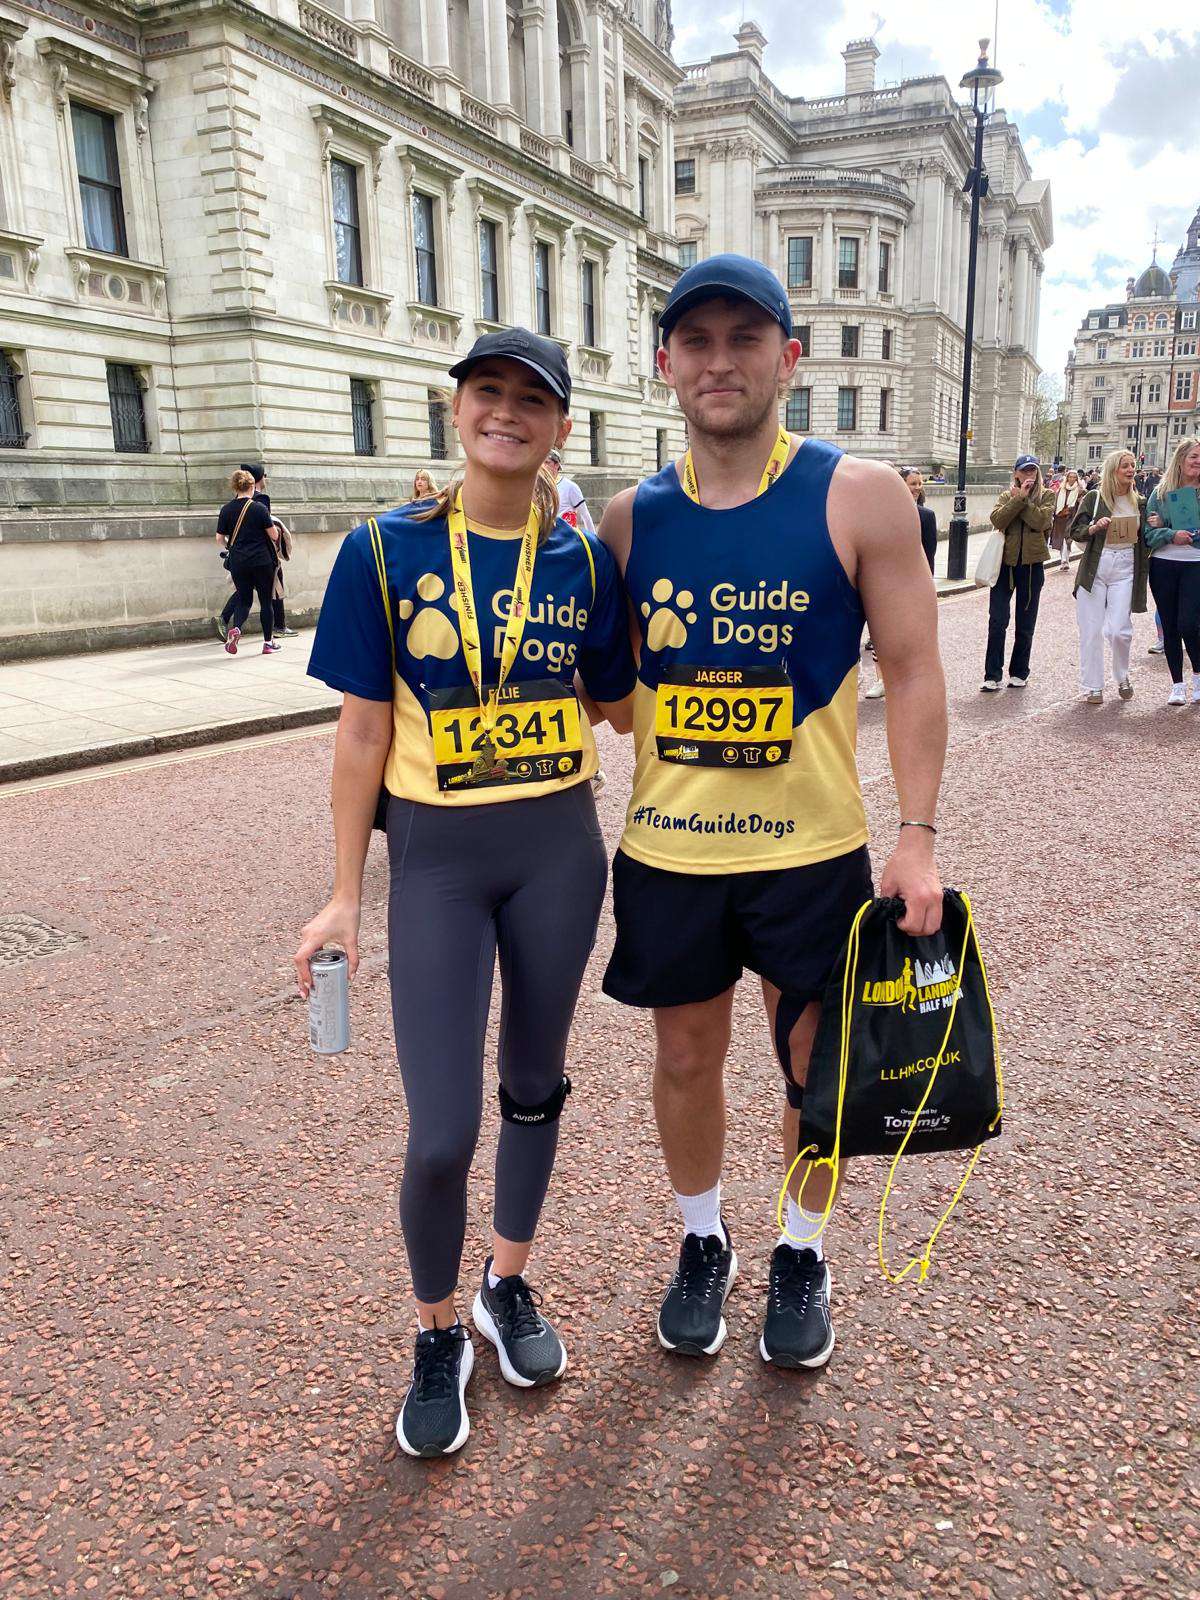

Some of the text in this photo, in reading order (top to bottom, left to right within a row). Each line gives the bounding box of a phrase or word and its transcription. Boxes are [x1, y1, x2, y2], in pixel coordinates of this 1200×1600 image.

[457, 581, 475, 620] FINISHER
[492, 589, 588, 631] Guide
[710, 580, 810, 612] Guide
[713, 616, 794, 653] Dogs
[695, 670, 742, 684] JAEGER
[664, 694, 784, 733] 12997
[444, 708, 568, 754] 12341
[633, 804, 795, 839] #TeamGuideDogs
[919, 998, 940, 1014] HALF
[880, 1050, 961, 1080] LLHM.COUK
[512, 1113, 545, 1122] AVIDDA
[884, 1114, 951, 1128] Tommy's
